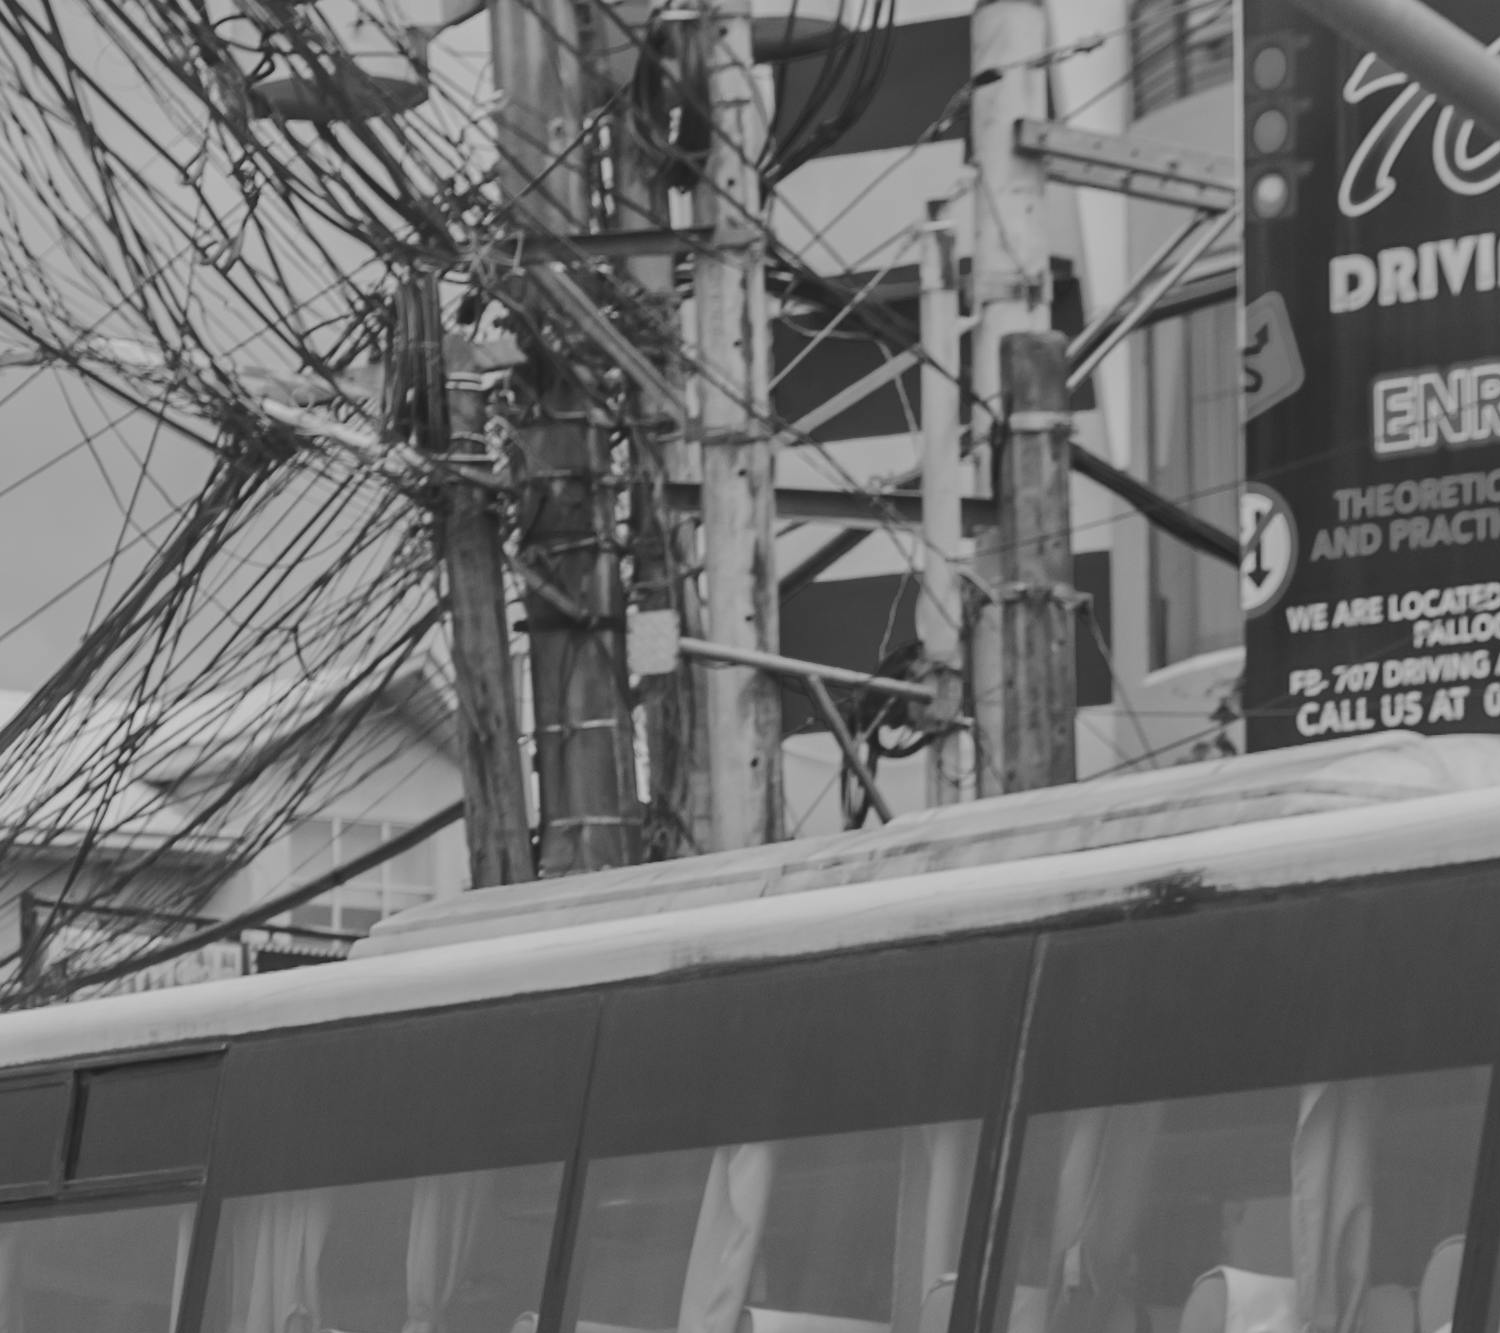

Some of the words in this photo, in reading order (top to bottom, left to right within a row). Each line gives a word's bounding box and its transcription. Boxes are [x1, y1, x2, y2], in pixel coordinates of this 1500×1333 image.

[1310, 523, 1383, 562] AND
[1285, 602, 1330, 634] WE
[1331, 595, 1384, 629] ARE
[1331, 661, 1380, 694] 707
[1381, 649, 1490, 689] DRIVING
[1296, 697, 1377, 737] CALL
[1380, 690, 1423, 728] US
[1427, 685, 1470, 724] AT
